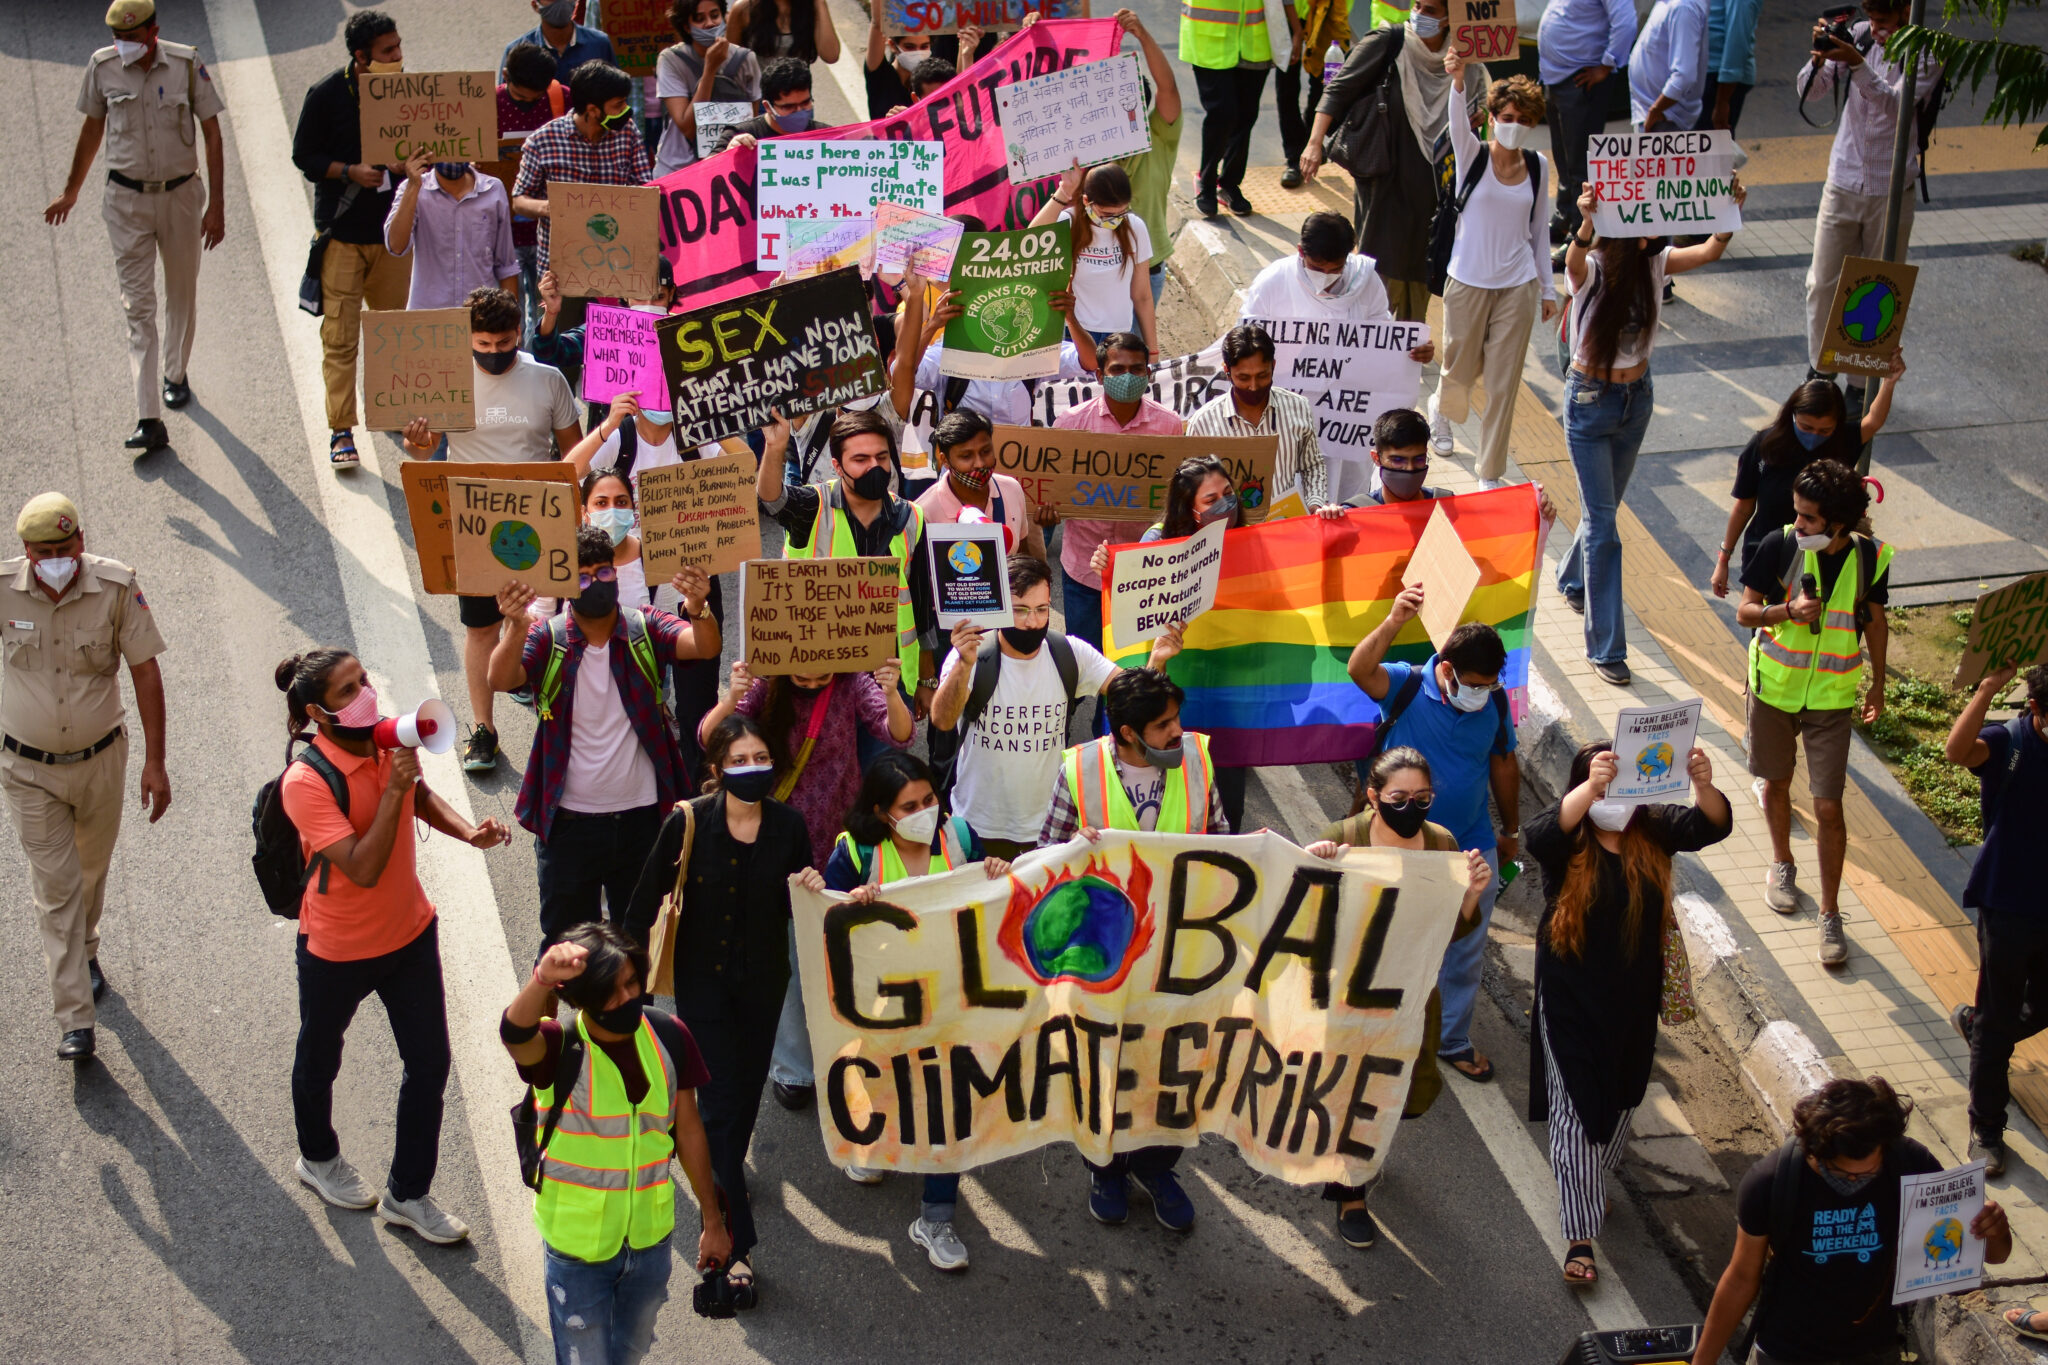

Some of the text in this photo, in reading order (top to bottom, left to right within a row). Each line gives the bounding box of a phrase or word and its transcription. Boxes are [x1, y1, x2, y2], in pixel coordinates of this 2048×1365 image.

[904, 0, 1019, 32] SO WILL
[1466, 1, 1499, 20] NOT
[1457, 25, 1517, 58] SEXY
[369, 74, 486, 102] CHANGE the
[399, 101, 464, 121] SYSTEM
[380, 123, 461, 138] NOT the
[761, 144, 776, 160] I
[785, 149, 814, 159] was
[821, 143, 860, 159] here
[868, 150, 885, 159] on
[1592, 134, 1712, 156] YOU FORCED
[761, 161, 899, 189] I was promised
[1589, 157, 1696, 179] THE SEA TO
[871, 179, 937, 196] climate
[1595, 178, 1735, 202] RISE AND NOW
[567, 192, 641, 211] MAKE
[761, 203, 818, 218] What's
[1618, 201, 1715, 223] WE WILL
[761, 233, 780, 260] I
[970, 230, 1061, 262] 24.09.
[961, 257, 1064, 279] KLIMASTREIK
[561, 271, 654, 295] AGAIN
[967, 284, 1037, 318] FRIDAYS FOR
[591, 309, 655, 333] HISTORY WILL
[805, 311, 863, 347] NOW
[373, 322, 468, 355] SYSTEM
[593, 327, 645, 347] REMEMBER
[676, 299, 788, 373] SEX
[992, 326, 1041, 357] FUTURE
[1336, 323, 1420, 351] NATURE
[593, 347, 646, 368] WHAT YOU
[680, 335, 878, 399] THAT I HAVE YOUR
[392, 371, 455, 390] NOT
[802, 356, 873, 398] STOP
[375, 389, 473, 407] CLIMATE
[677, 370, 799, 424] ATTENTION,
[788, 370, 883, 414] THE PLANET.
[1315, 389, 1371, 413] ARE
[1000, 440, 1165, 479] OUR HOUSE
[640, 467, 685, 487] EARTH IS
[738, 476, 756, 486] AND
[457, 483, 562, 518] THERE IS
[1071, 481, 1141, 509] SAVE
[644, 497, 704, 517] WHAT ARE WE
[458, 514, 487, 536] NO
[645, 530, 667, 544] STOP
[717, 518, 756, 531] PROBLEMS
[649, 535, 736, 561] WHEN THERE ARE
[1142, 537, 1207, 570] No one can
[549, 549, 572, 582] B
[751, 561, 900, 579] THE EARTH ISN'T DYING
[1117, 549, 1219, 595] escape the wrath
[805, 579, 899, 601] BEEN KILLED
[1139, 577, 1202, 609] of Nature!
[750, 602, 895, 622] AND THOSE WHO ARE
[1137, 596, 1202, 632] BEWARE!!!
[827, 623, 861, 639] HAVE
[750, 645, 868, 665] AND ADDRESSES
[1629, 718, 1689, 734] I'M STRIKING FOR
[1634, 709, 1688, 725] I BELIEVE
[973, 733, 1064, 753] TRANSIENT
[1647, 730, 1670, 741] FACTS
[1618, 786, 1645, 795] CLIMATE
[1646, 783, 1668, 793] ACTION
[1920, 1175, 1974, 1196] I BELIEVE
[1915, 1186, 1976, 1209] I'M STRIKING FOR
[1813, 1207, 1858, 1225] READY
[1934, 1203, 1959, 1216] FACTS
[1812, 1225, 1854, 1237] FOR THE
[1812, 1233, 1878, 1252] WEEKEND
[1906, 1268, 1974, 1288] CLIMATE ACTION NOW
